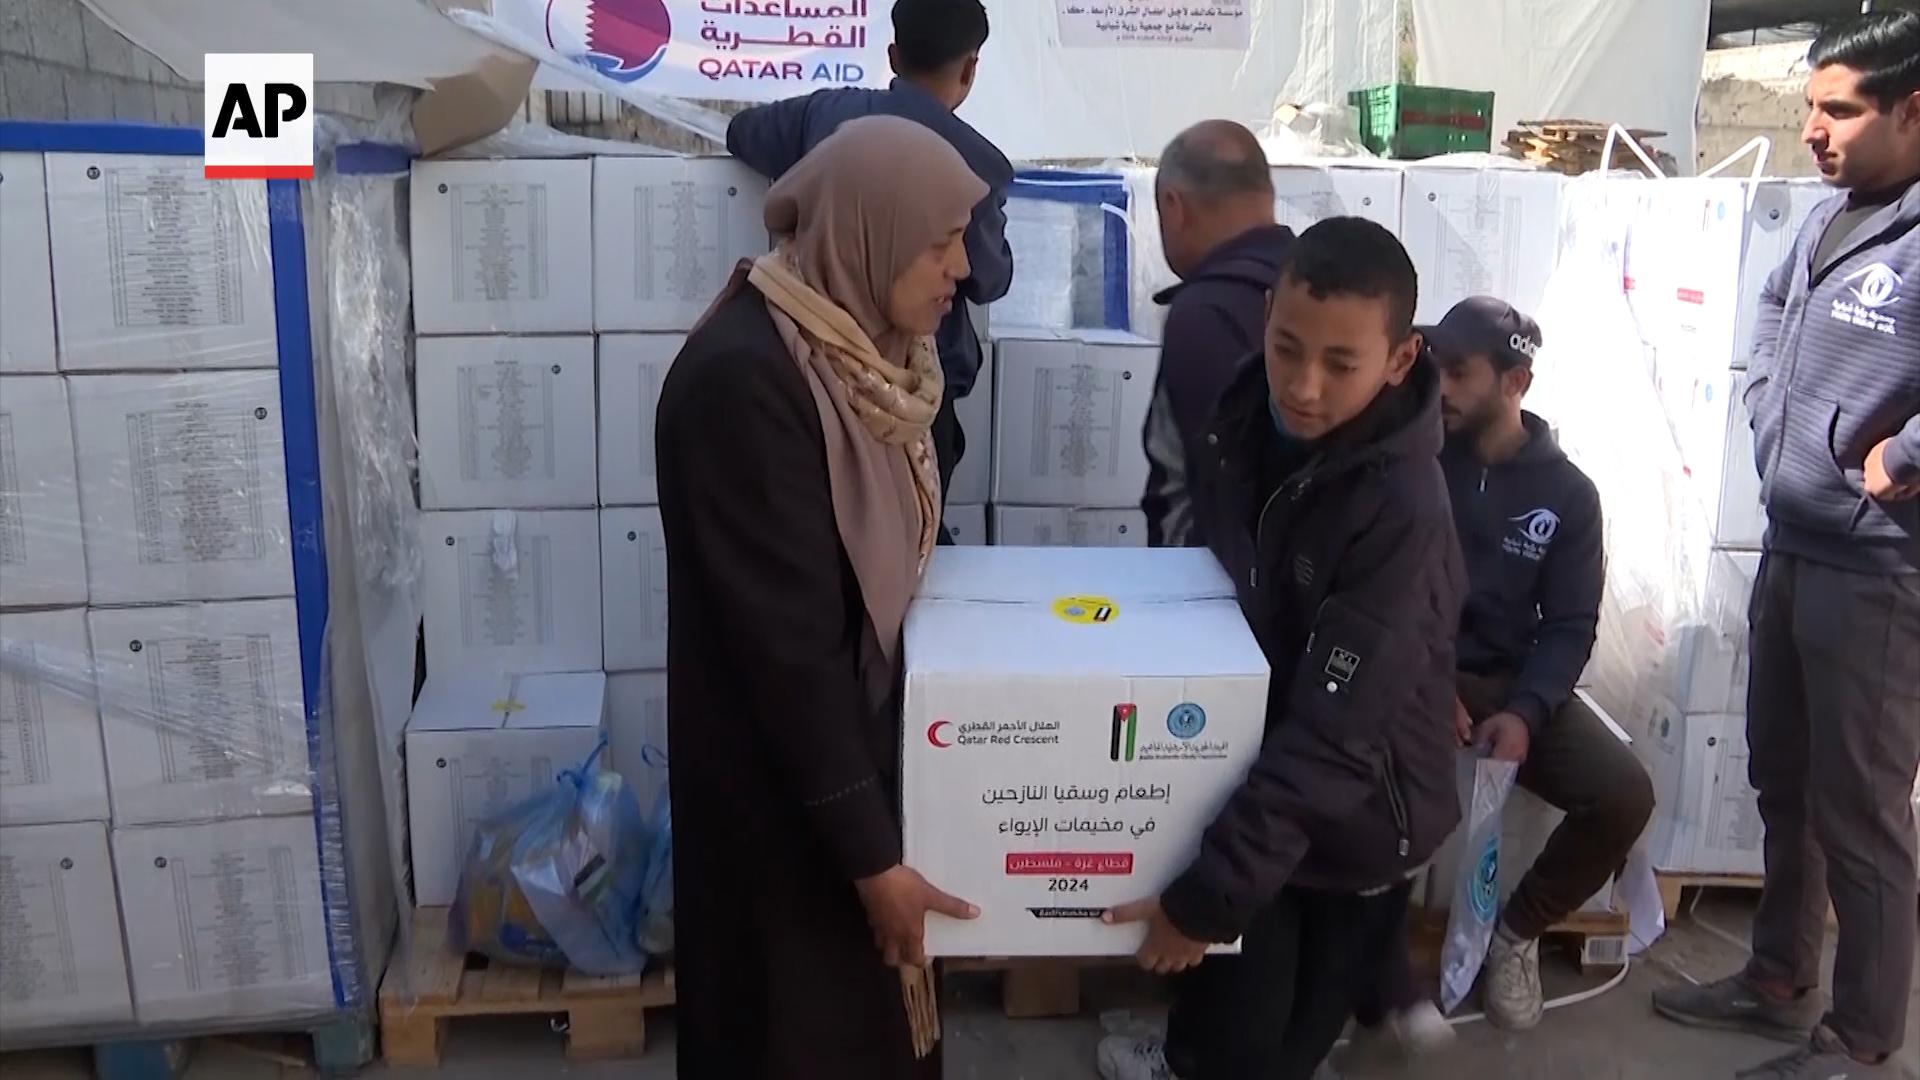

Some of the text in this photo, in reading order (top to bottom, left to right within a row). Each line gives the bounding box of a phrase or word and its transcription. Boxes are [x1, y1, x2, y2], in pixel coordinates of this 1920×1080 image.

[699, 58, 865, 82] QATAR AID
[958, 720, 1060, 734] الهلال الأحمر القطري
[957, 734, 1060, 745] Qatar Red Crescent
[982, 783, 1171, 804] إطعام وسقيا النازحين
[998, 817, 1156, 839] في مخيمات الإيواء
[1009, 857, 1062, 870] فلسطين
[1074, 857, 1094, 870] غزة
[1097, 857, 1129, 871] قطاع
[1048, 877, 1089, 892] 2024
